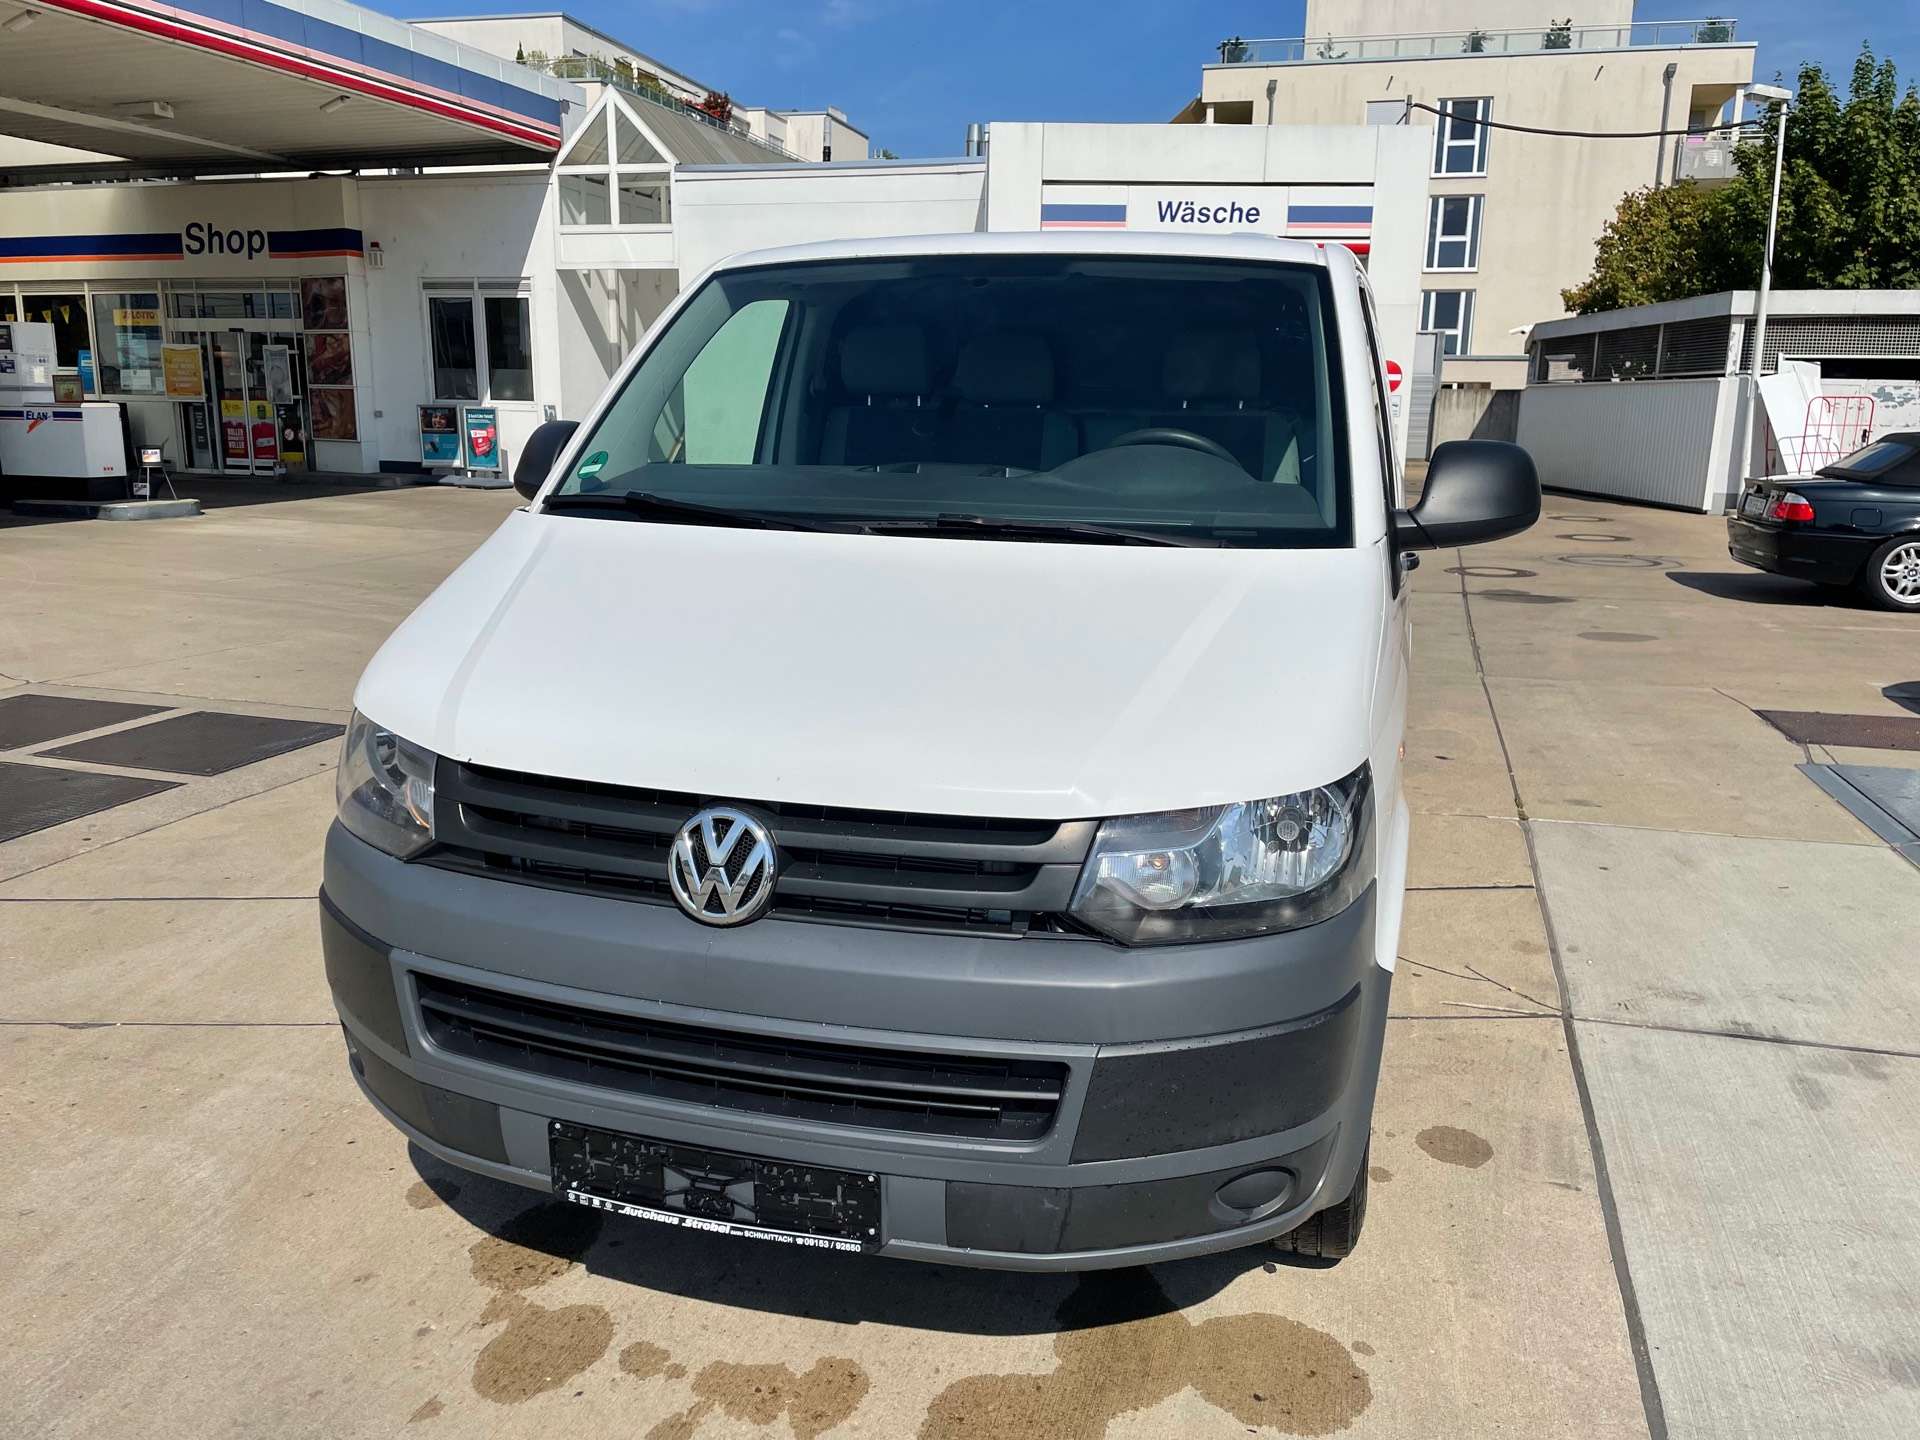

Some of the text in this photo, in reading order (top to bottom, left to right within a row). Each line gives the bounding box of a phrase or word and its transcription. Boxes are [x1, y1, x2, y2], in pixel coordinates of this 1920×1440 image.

[1157, 200, 1261, 224] Wäsche
[185, 222, 266, 260] Shop
[26, 410, 49, 421] ELAN
[618, 1206, 680, 1225] Autohaus
[681, 1218, 730, 1234] Strobel
